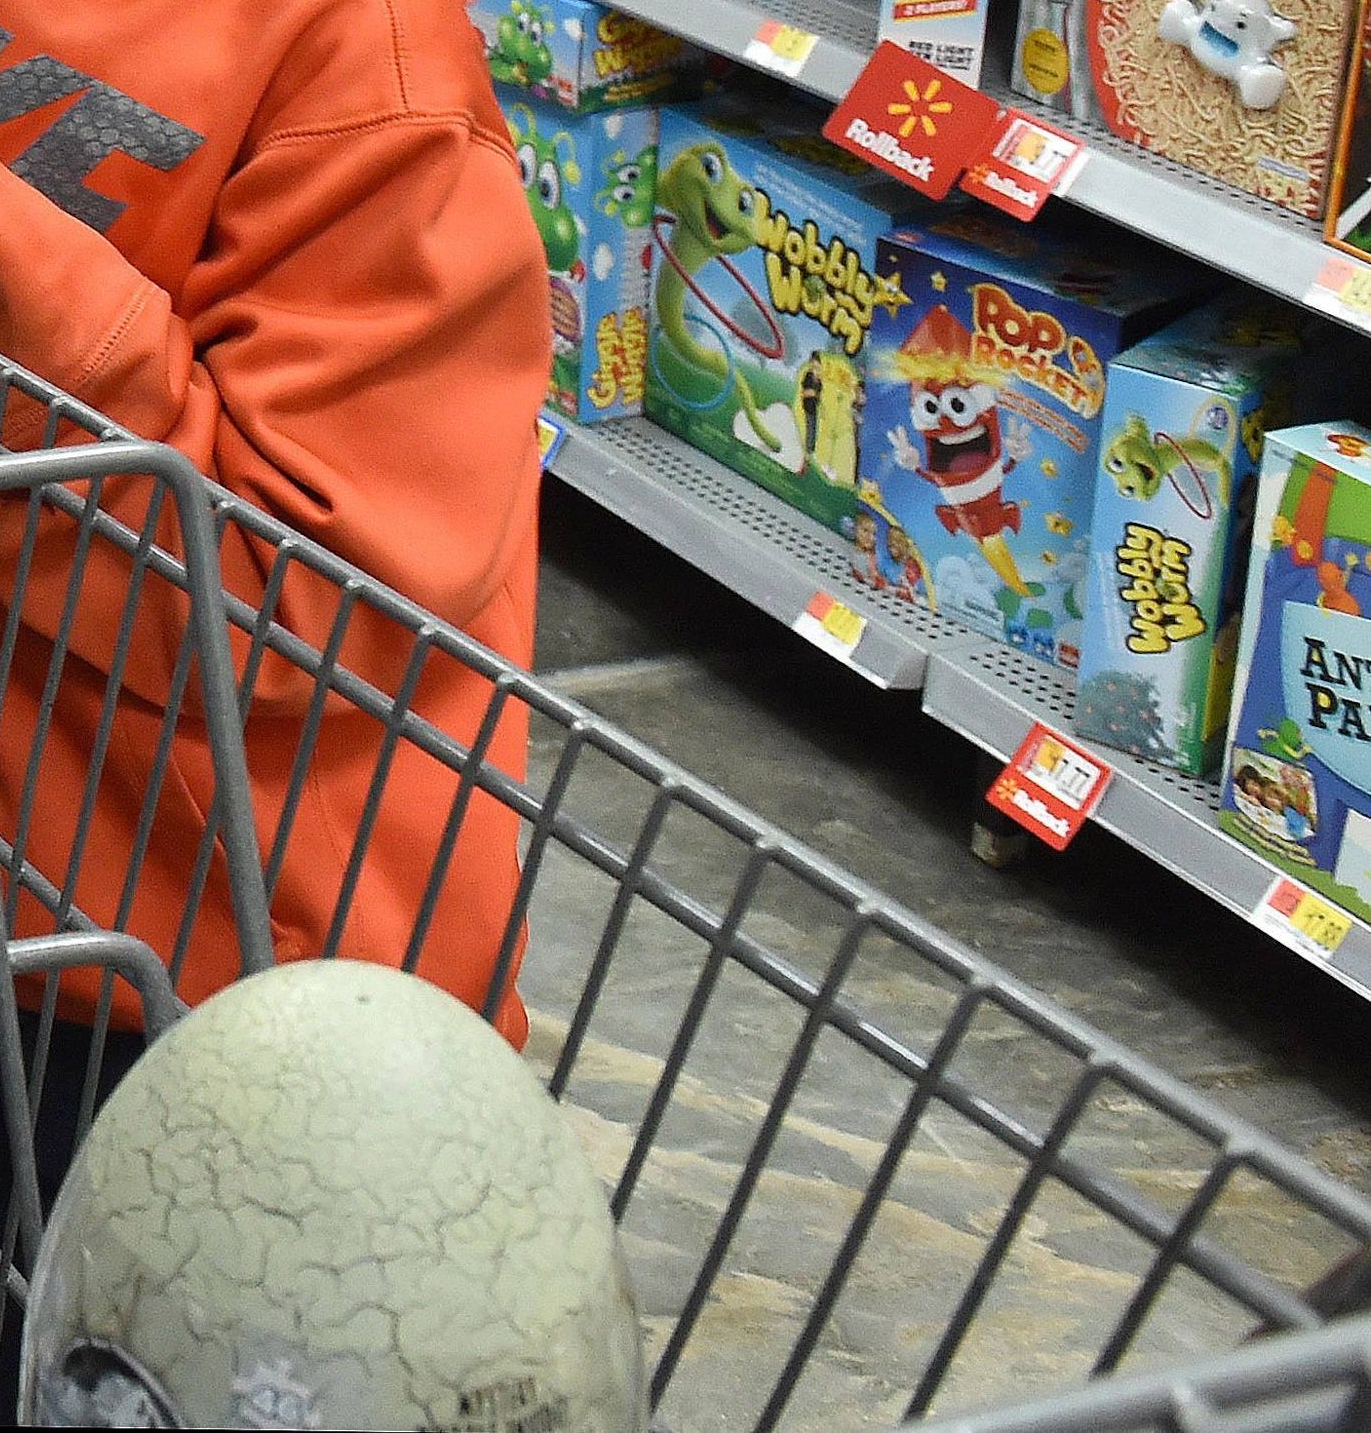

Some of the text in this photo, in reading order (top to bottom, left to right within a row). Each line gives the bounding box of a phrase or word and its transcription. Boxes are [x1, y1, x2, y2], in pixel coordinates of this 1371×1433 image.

[844, 117, 935, 182] Rollback
[753, 187, 875, 329] Wobbly
[1116, 522, 1171, 654] Wobbly
[1299, 636, 1371, 690] AN
[1306, 682, 1371, 742] PA
